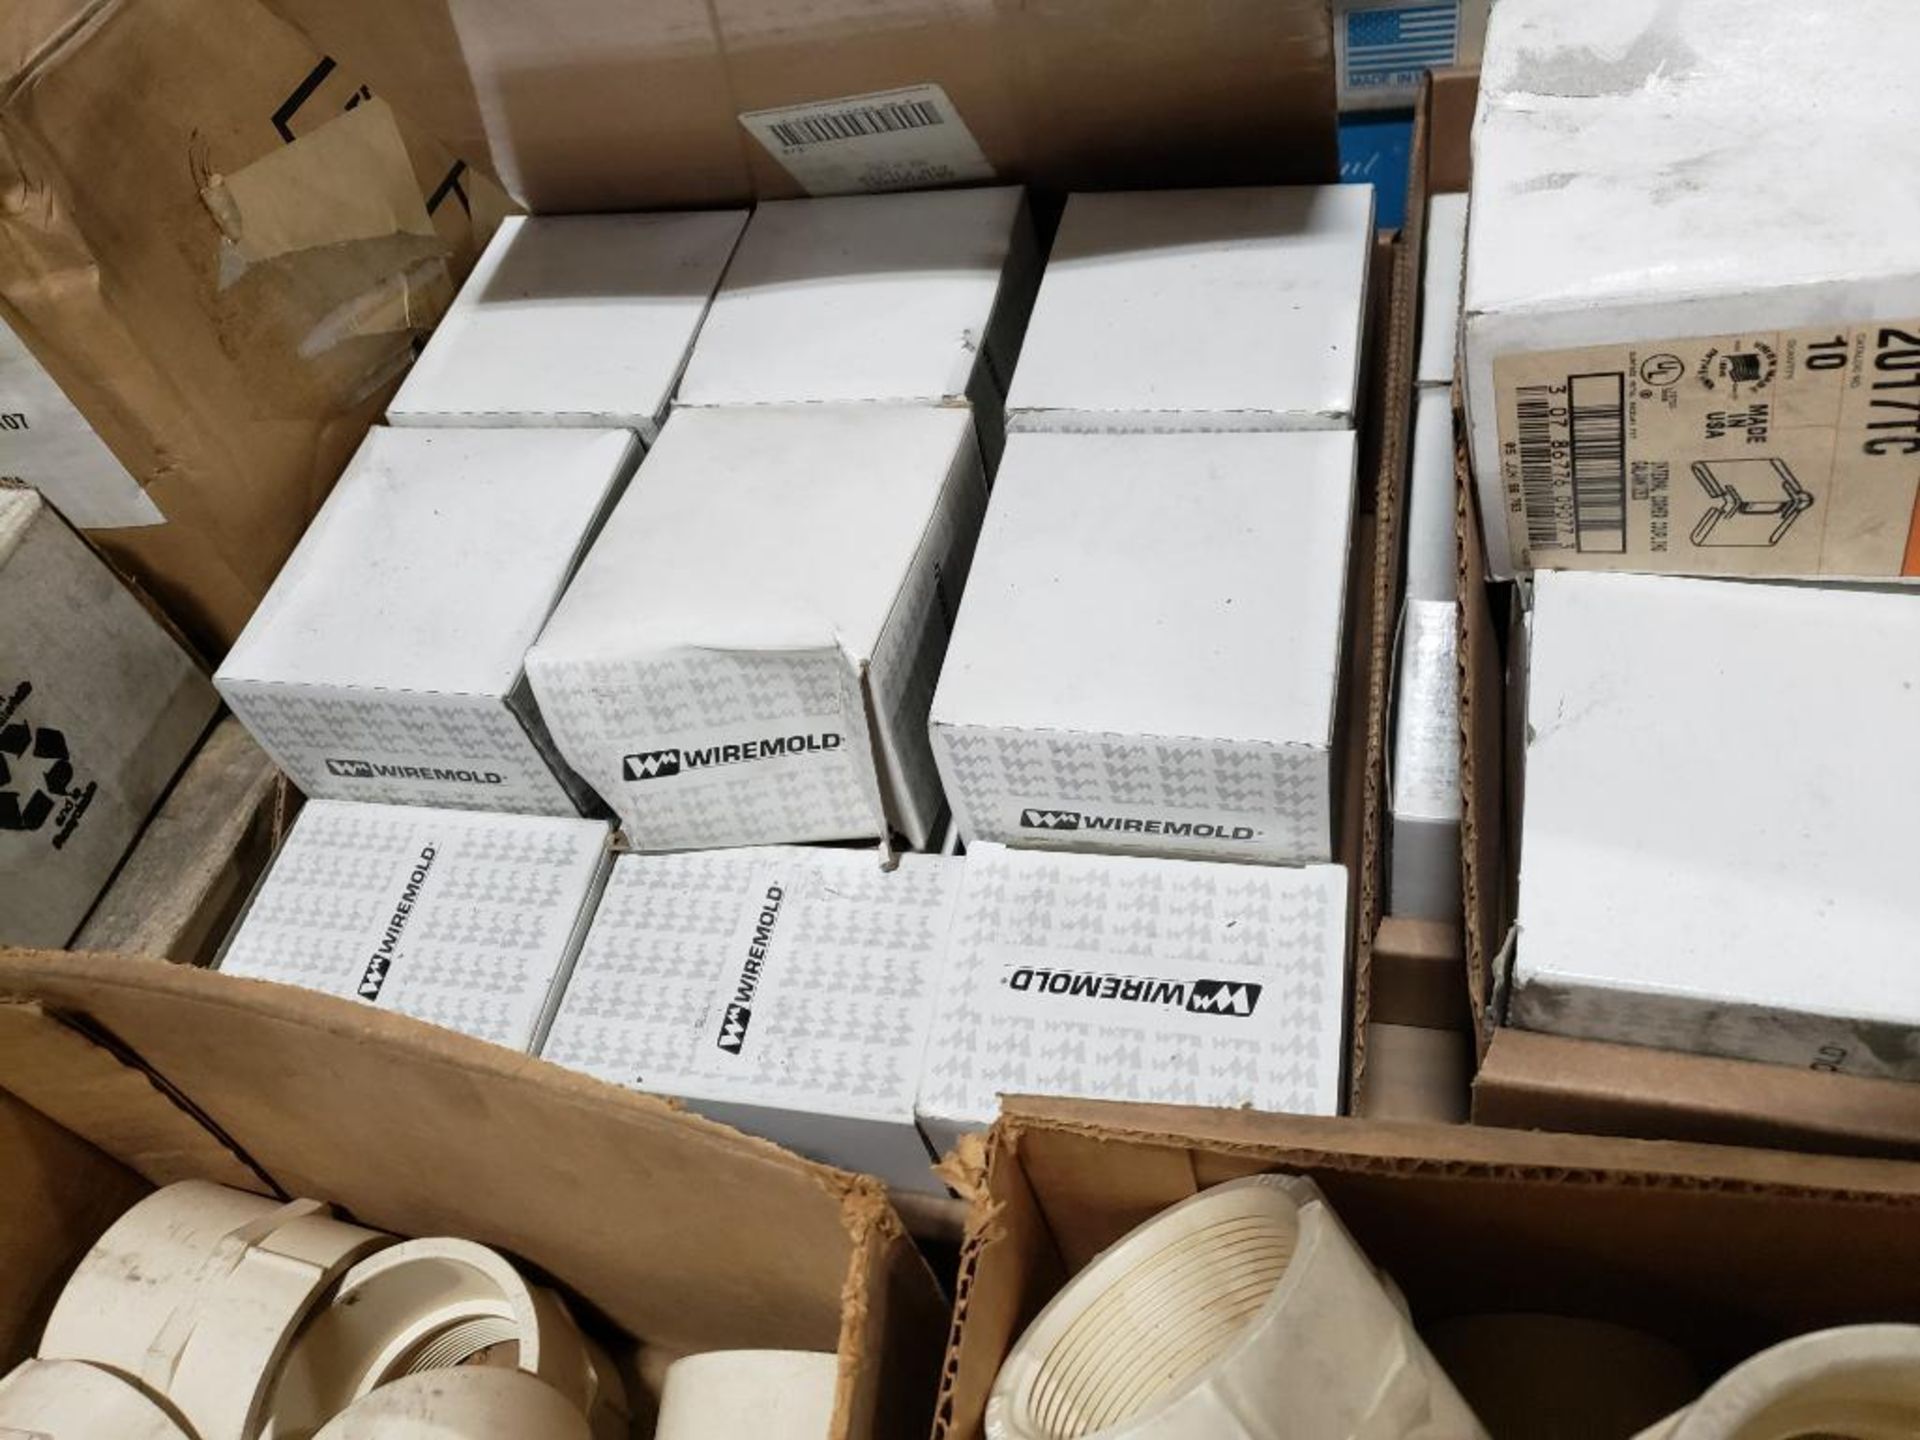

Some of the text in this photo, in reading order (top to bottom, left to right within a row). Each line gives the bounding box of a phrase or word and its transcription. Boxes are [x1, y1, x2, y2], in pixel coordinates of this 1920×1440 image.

[1805, 335, 1849, 370] 10
[1548, 385, 1567, 394] 3
[0, 413, 29, 430] 07
[1549, 407, 1568, 427] 07
[1705, 411, 1726, 440] USA
[1727, 413, 1747, 428] IN
[1747, 403, 1769, 445] MADE
[1551, 439, 1571, 488] 86776
[683, 733, 841, 768] WIREMOLD
[373, 763, 503, 784] WIREMOLD
[1083, 815, 1255, 840] WIREMOLD
[378, 846, 436, 954] WIREMOLD
[734, 886, 783, 1002] WIREMOLD
[1010, 969, 1185, 1006] WIREMOLD
